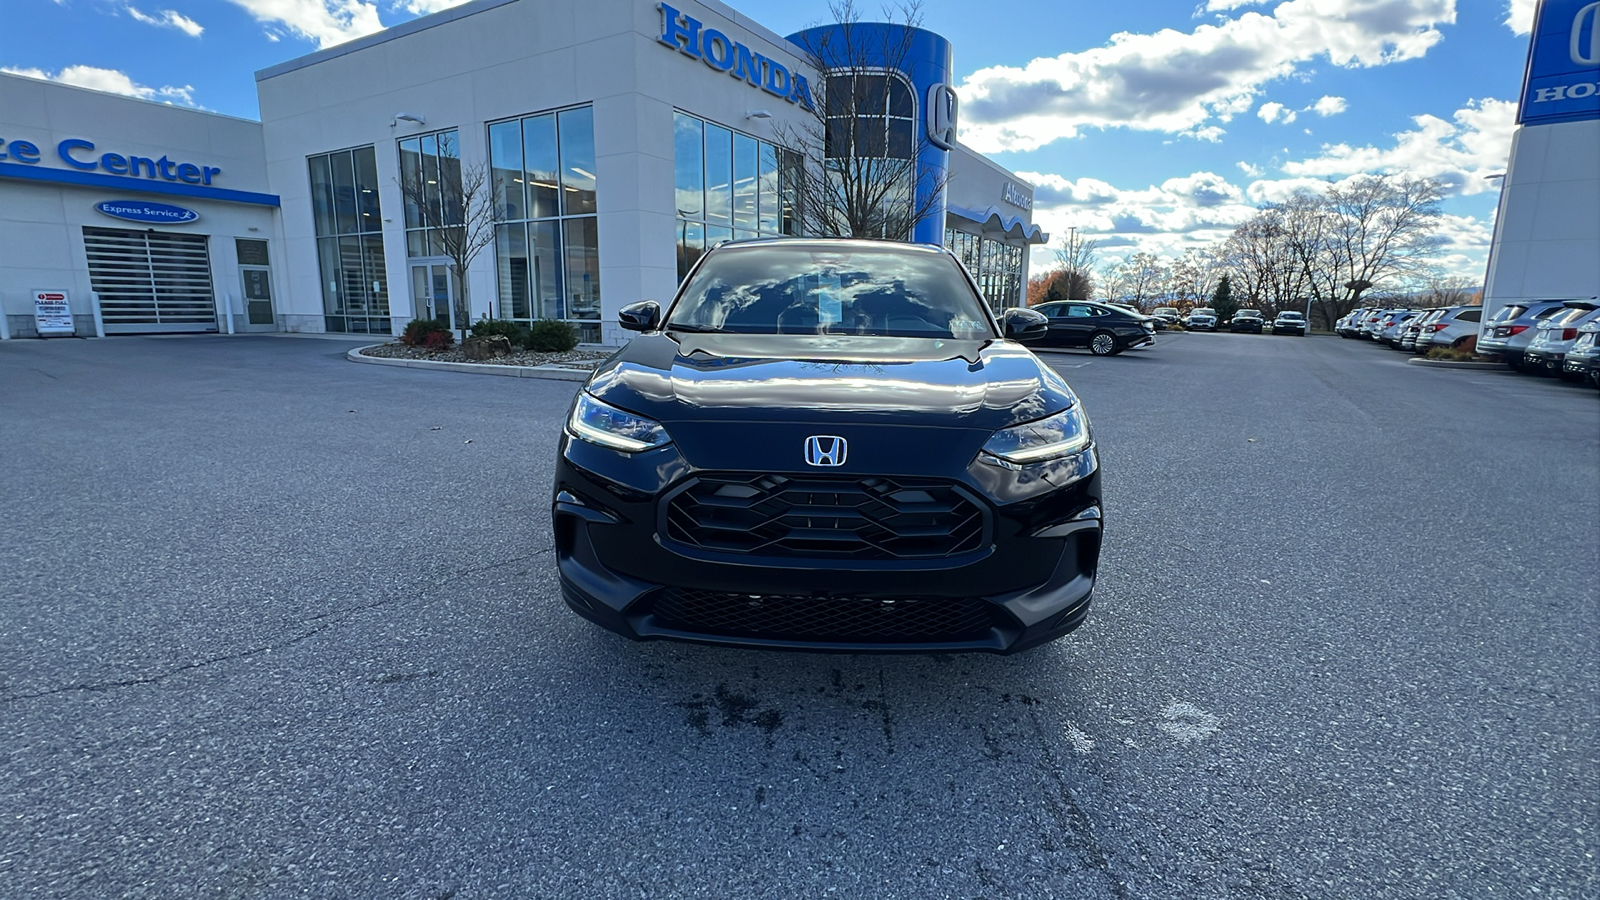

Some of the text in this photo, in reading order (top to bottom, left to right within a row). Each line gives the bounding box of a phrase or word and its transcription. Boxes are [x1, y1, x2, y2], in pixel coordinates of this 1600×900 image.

[656, 2, 815, 112] HONDA
[1533, 81, 1600, 103] HO
[57, 138, 221, 185] Center
[102, 203, 179, 217] Express Service
